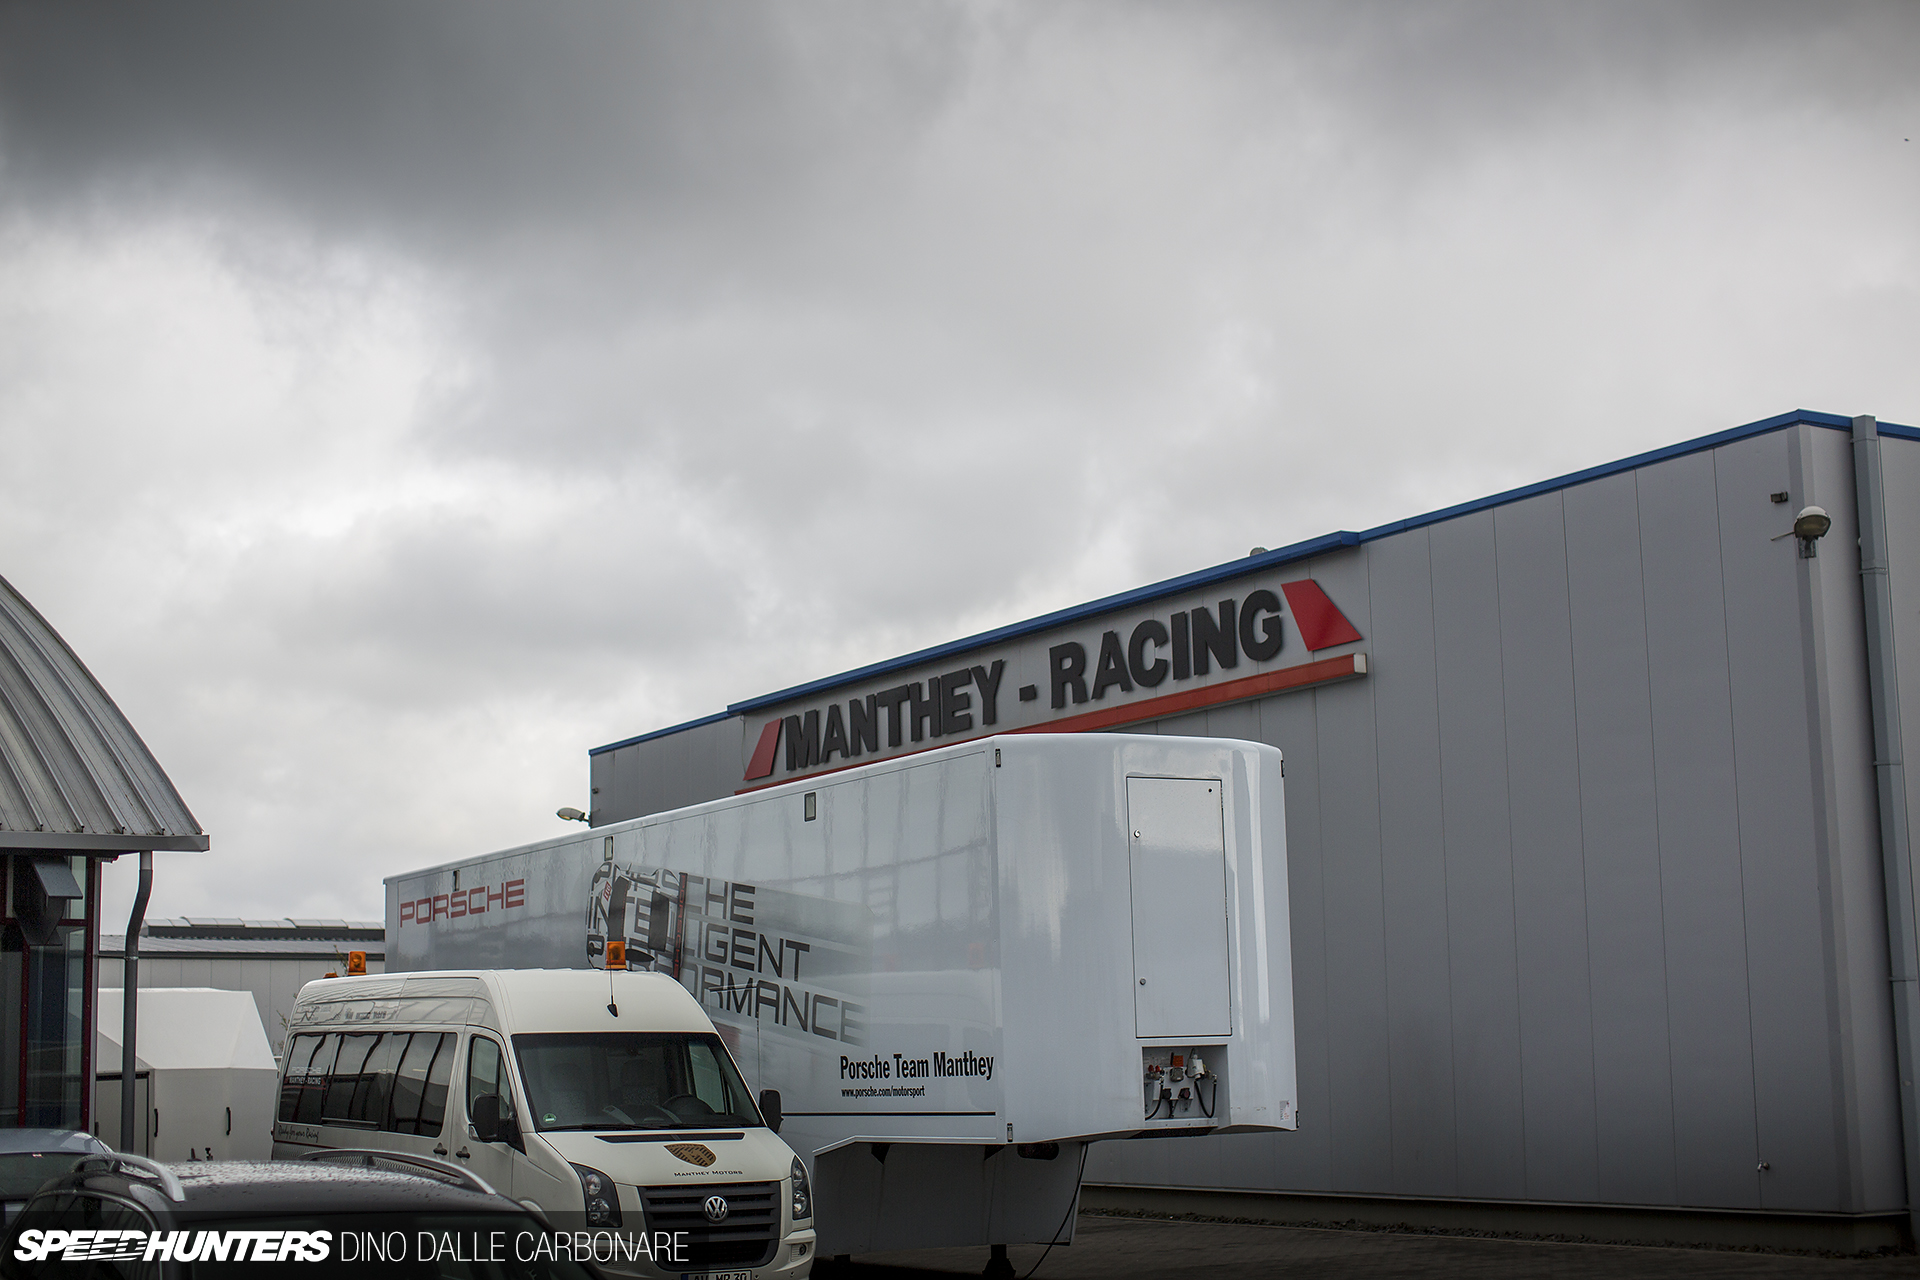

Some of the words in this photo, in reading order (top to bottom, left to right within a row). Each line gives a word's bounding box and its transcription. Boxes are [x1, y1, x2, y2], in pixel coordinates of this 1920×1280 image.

[785, 659, 1003, 771] MANTHEY
[1049, 589, 1283, 709] RACING
[400, 878, 525, 928] PORSCHE
[840, 1054, 891, 1080] Porsche
[893, 1053, 930, 1079] Team
[933, 1050, 995, 1081] Manthey
[841, 1085, 926, 1099] www.porsche.com/motorsport
[673, 1170, 710, 1178] MANTHEY
